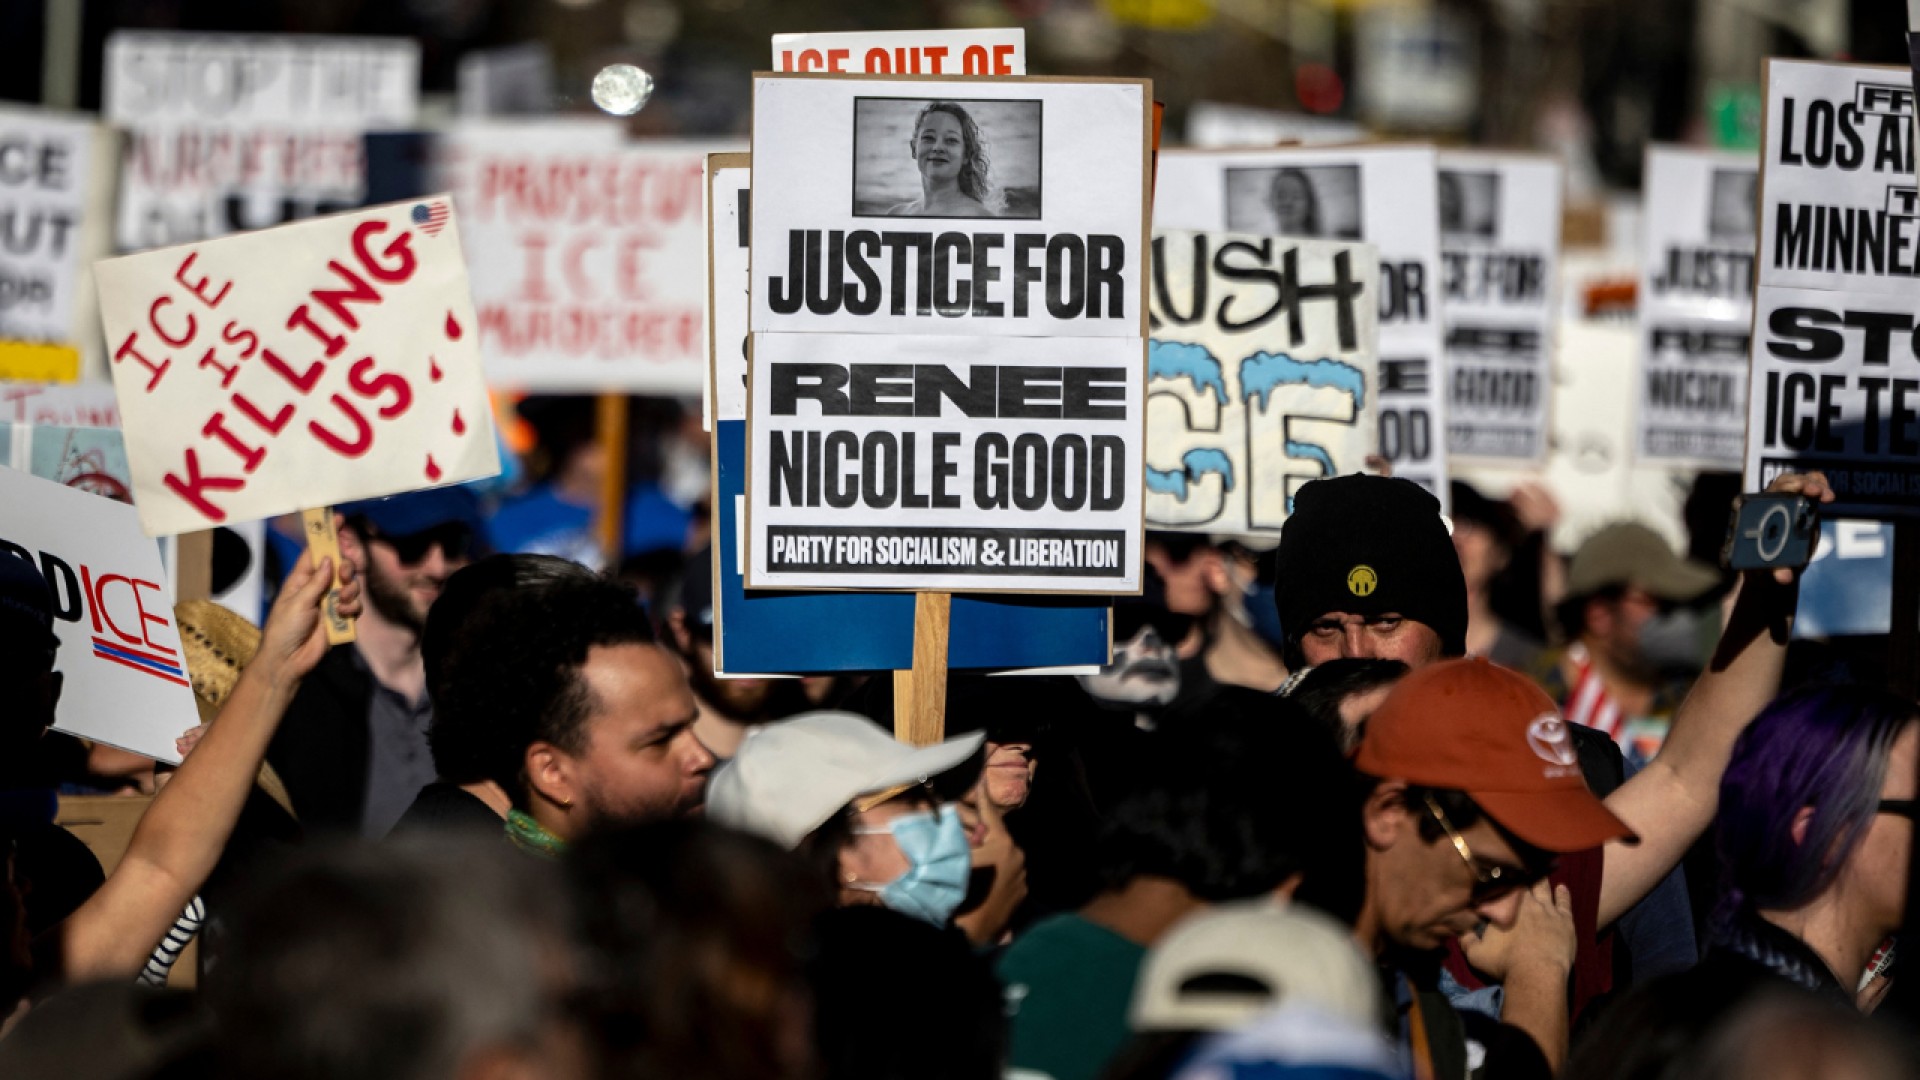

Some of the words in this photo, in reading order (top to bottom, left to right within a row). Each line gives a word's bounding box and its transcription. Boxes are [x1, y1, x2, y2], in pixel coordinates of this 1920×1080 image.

[1780, 97, 1865, 171] LOS
[1874, 113, 1915, 174] A
[768, 228, 1004, 317] JUSTICE
[1013, 232, 1126, 320] FOR
[1148, 234, 1365, 352] USH
[114, 251, 234, 392] ICE
[198, 319, 260, 389] IS
[1766, 306, 1920, 366] ST
[162, 219, 419, 523] KILLING
[307, 355, 414, 459] US
[770, 362, 1127, 420] RENEE
[1763, 371, 1847, 455] ICE
[769, 430, 961, 509] NICOLE
[973, 431, 1126, 512] GOOD
[772, 535, 833, 564] PARTY
[836, 537, 873, 565] FOR
[875, 537, 977, 566] SOCIALISM
[980, 540, 1006, 567] &
[1009, 538, 1119, 568] LIBERATION
